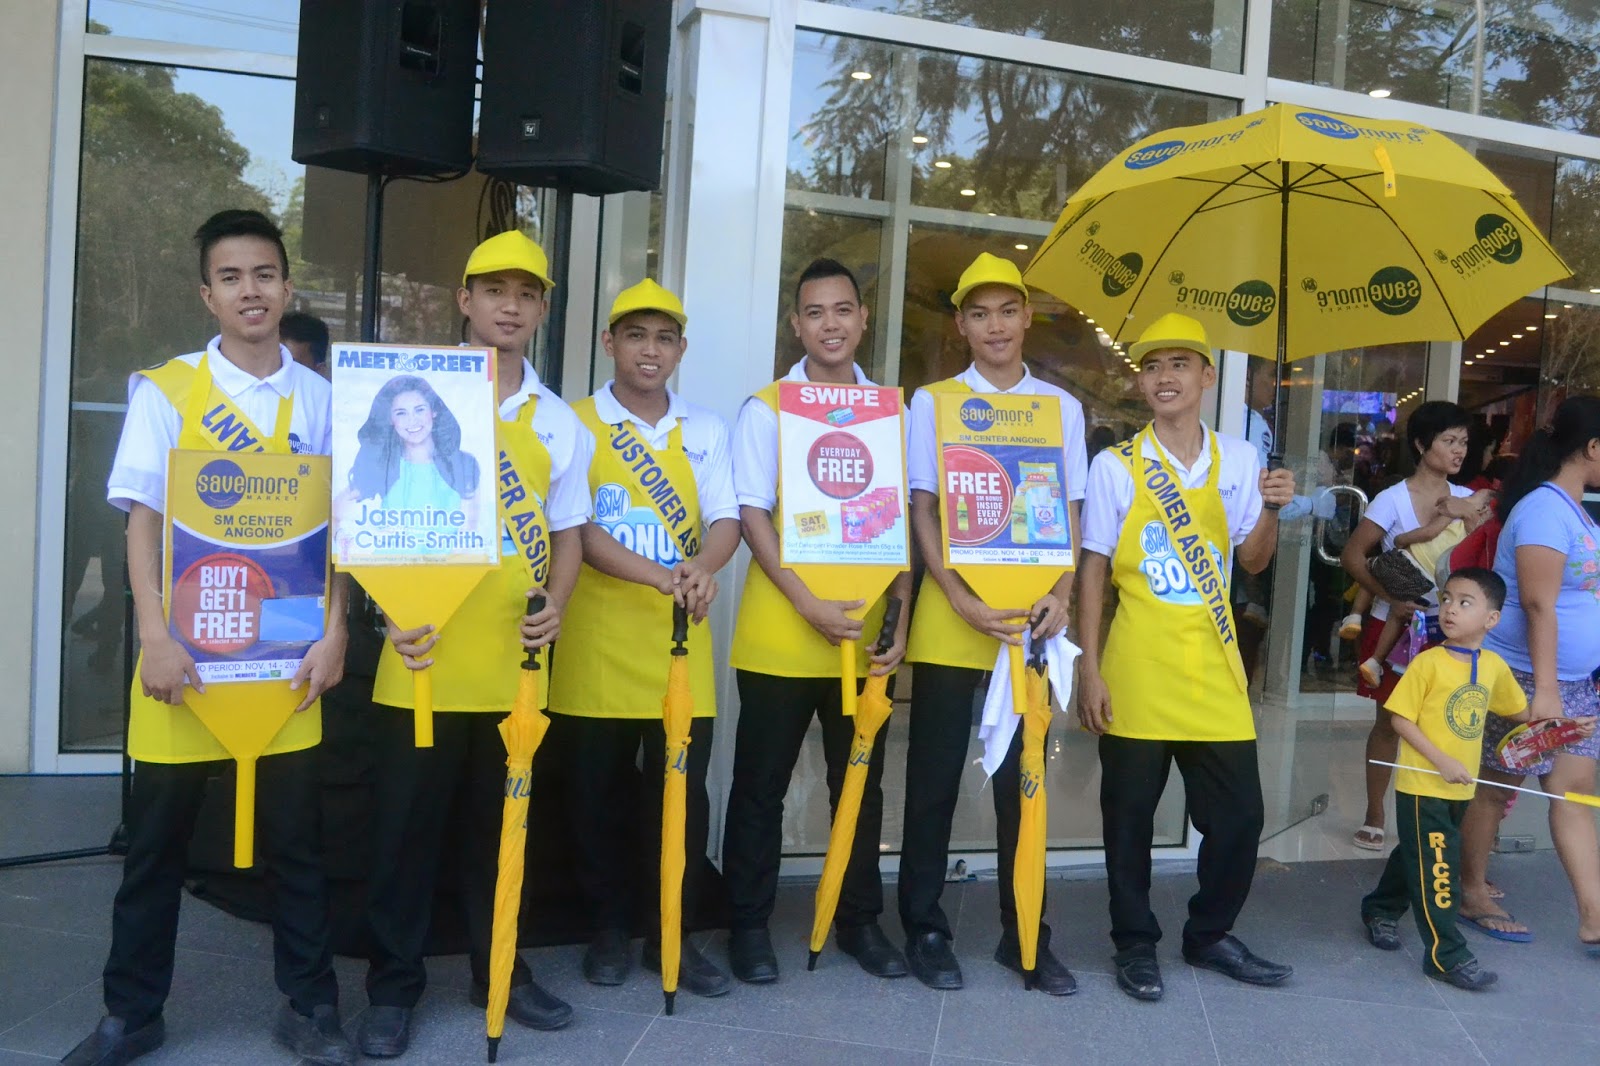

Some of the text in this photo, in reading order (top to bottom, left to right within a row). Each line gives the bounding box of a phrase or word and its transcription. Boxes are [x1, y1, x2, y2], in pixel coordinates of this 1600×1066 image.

[800, 386, 880, 407] SWIPE
[960, 407, 1033, 423] savemore
[974, 435, 1008, 443] CENTER
[1010, 436, 1047, 444] ANGONO
[820, 447, 861, 458] EVERYDAY
[817, 458, 866, 483] FREE
[197, 474, 299, 495] savemore
[947, 471, 1001, 495] FREE
[976, 502, 1003, 510] INSIDE
[977, 510, 1001, 518] EVERY
[213, 515, 293, 526] SM CENTER
[355, 504, 466, 527] Jasmine
[801, 515, 821, 527] SAT
[977, 518, 999, 526] PACK
[224, 527, 284, 538] ANGONO
[355, 530, 484, 549] Curtis-Smith
[1177, 534, 1234, 644] ASSISTANT
[193, 612, 254, 639] FREE
[208, 662, 244, 673] PERIOD:
[1428, 832, 1452, 909] RICCC
